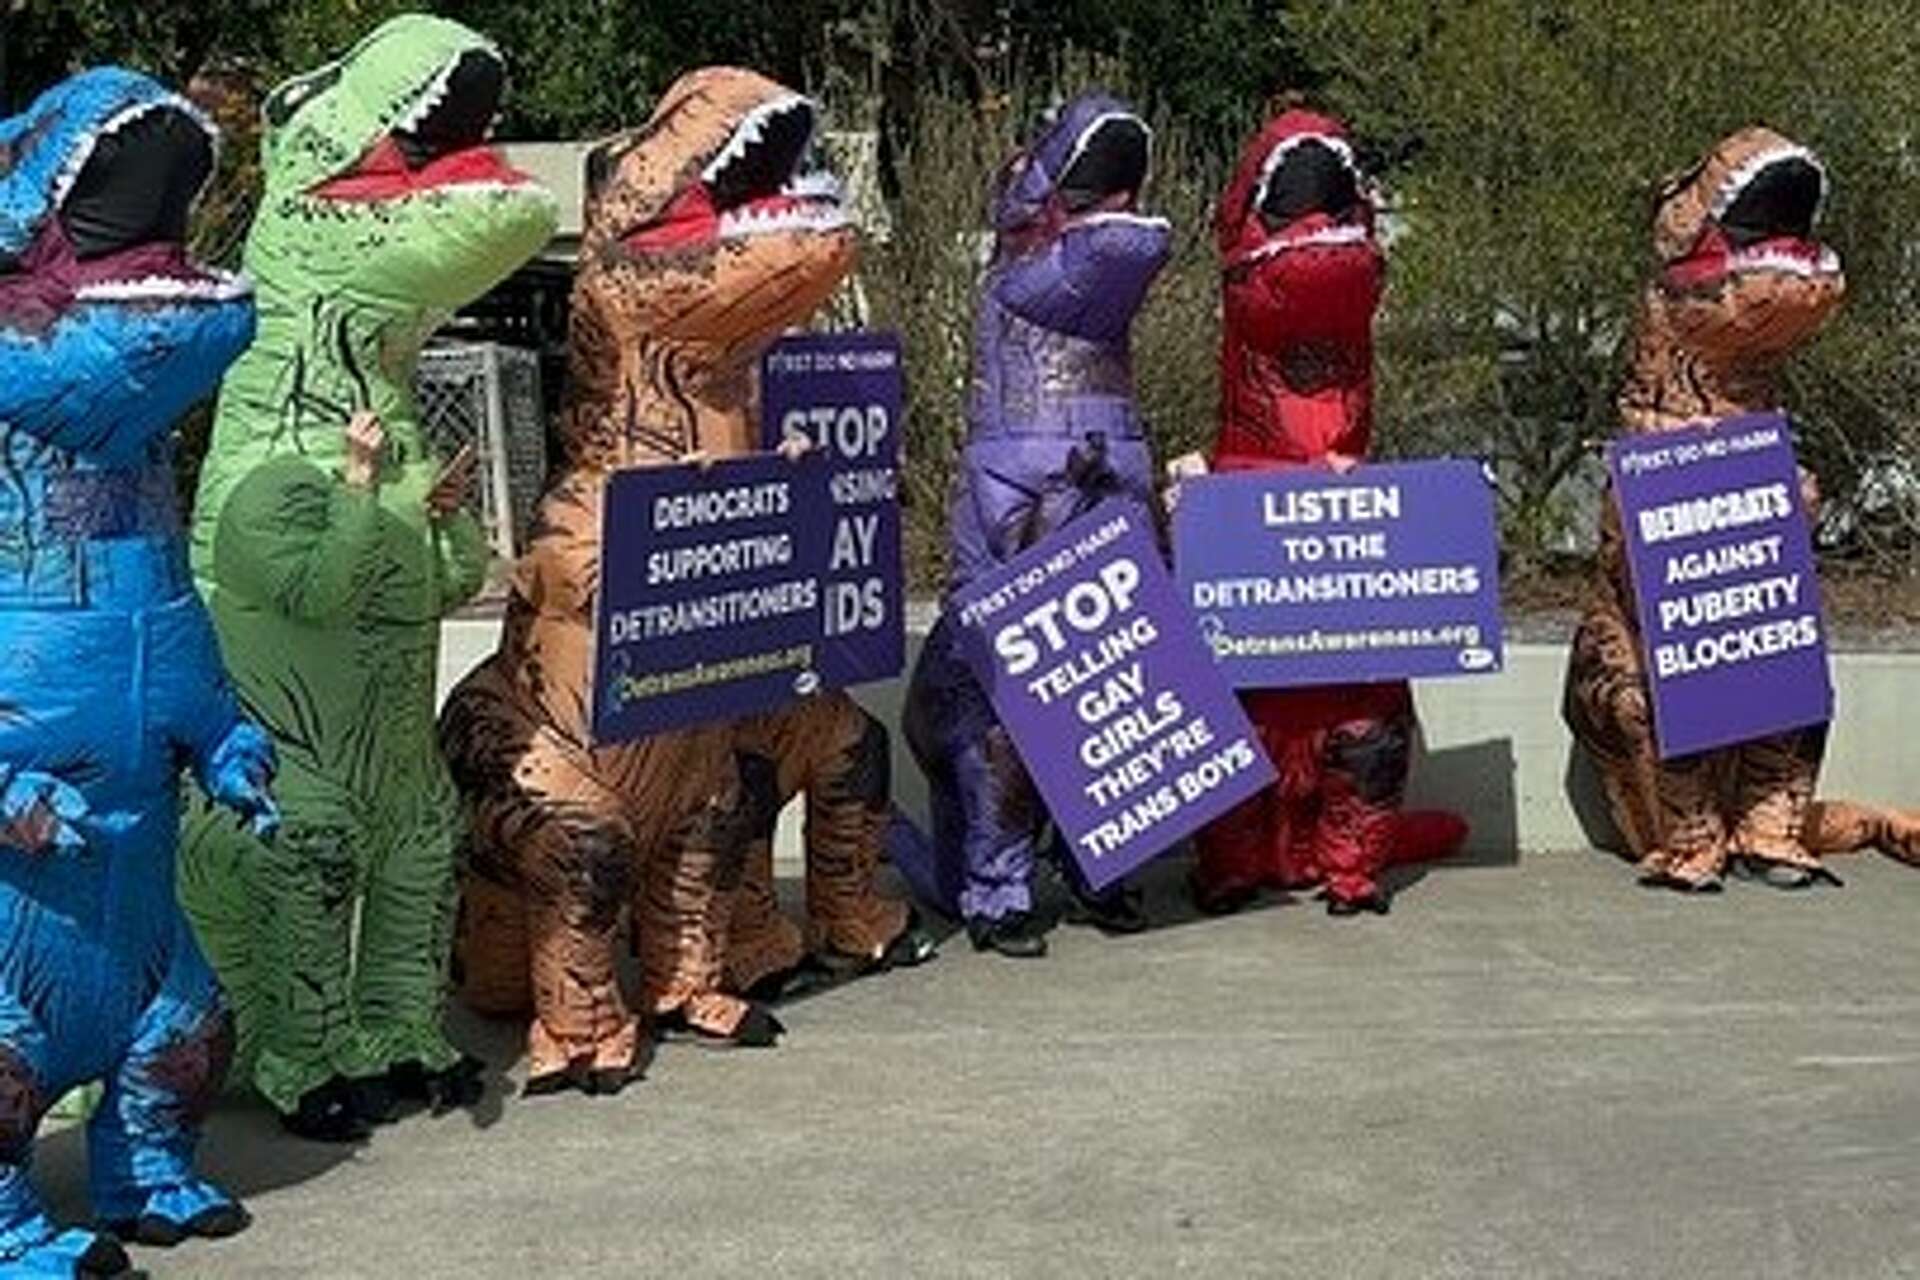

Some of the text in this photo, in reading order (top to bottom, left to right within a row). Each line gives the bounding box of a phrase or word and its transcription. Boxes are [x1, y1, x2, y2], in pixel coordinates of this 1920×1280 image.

[782, 405, 889, 458] STOP
[653, 482, 790, 530] DEMOCRATS
[1263, 486, 1401, 526] LISTEN
[1639, 483, 1792, 544] DEMOCRATS
[647, 534, 791, 585] SUPPORTING
[830, 515, 879, 571] AY
[1014, 566, 1045, 594] DO
[1046, 549, 1076, 574] NO
[1283, 532, 1388, 562] TO THE
[1667, 535, 1783, 584] AGAINST
[610, 578, 818, 645] DETRANSITIONERS
[824, 577, 885, 637] IDS
[1193, 566, 1480, 608] DETRANSITIONERS
[1658, 574, 1800, 631] PUBERTY
[995, 559, 1140, 675] STOP
[1028, 616, 1158, 703] TELLING
[1654, 615, 1818, 678] BLOCKERS
[1077, 663, 1146, 723] GAY
[1080, 691, 1183, 769] GIRLS
[1085, 716, 1215, 807] THEY'RE
[1079, 738, 1257, 858] TRANS BOYS
